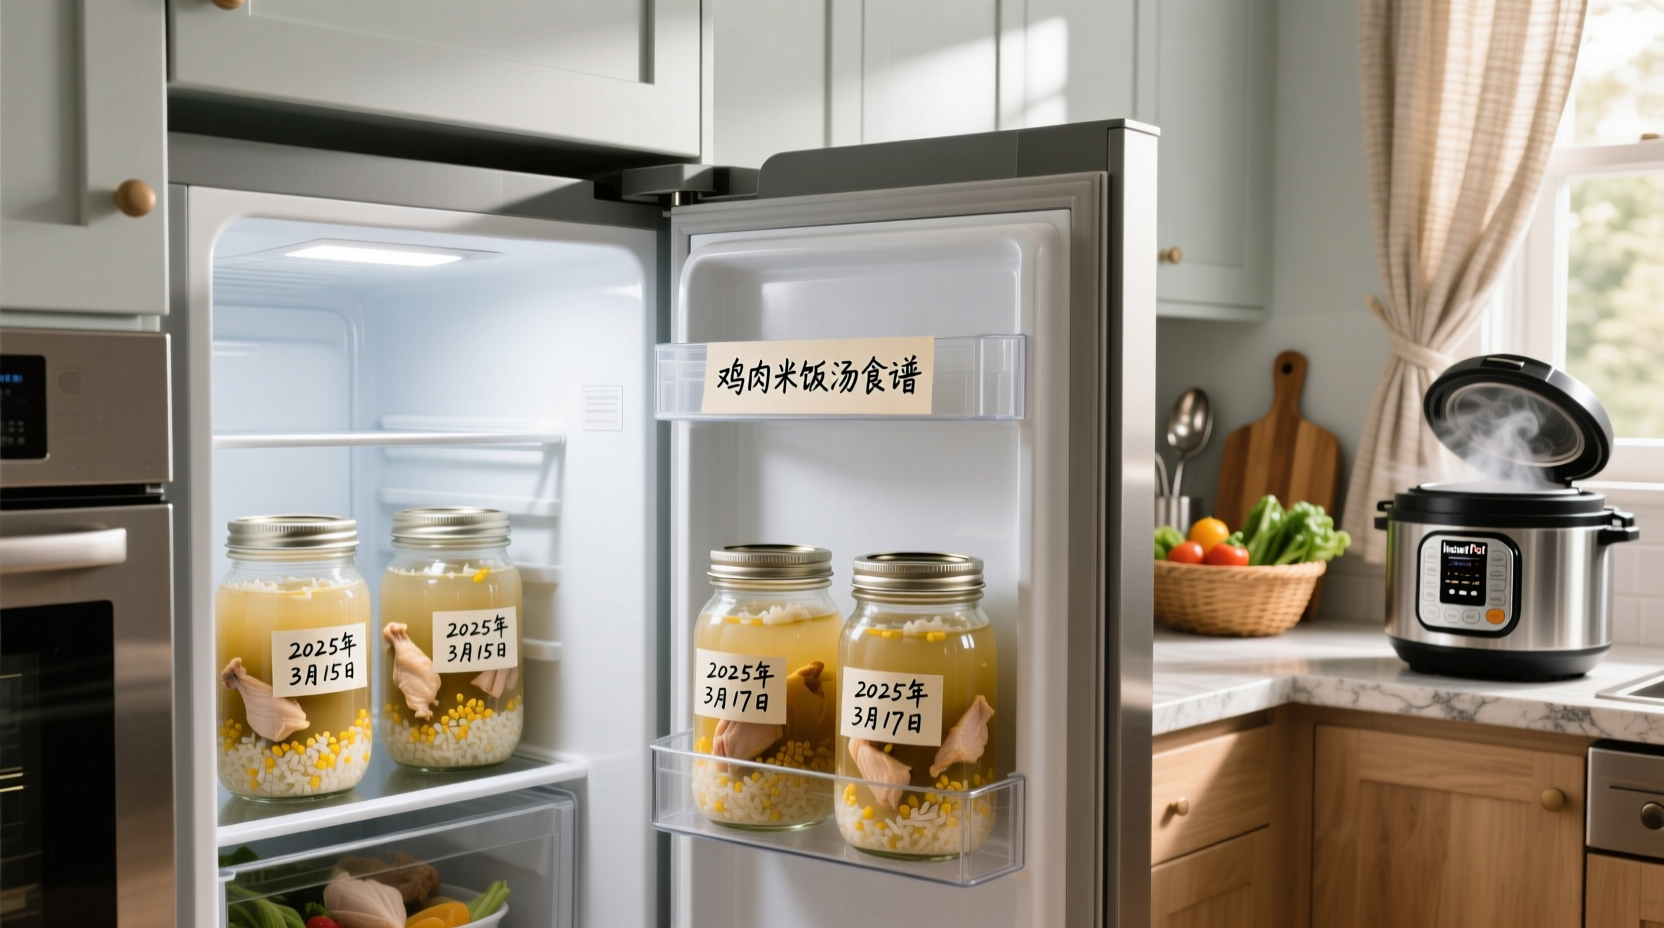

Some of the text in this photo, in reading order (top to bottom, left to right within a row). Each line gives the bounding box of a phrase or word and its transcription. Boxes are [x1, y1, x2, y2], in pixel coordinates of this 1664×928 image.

[717, 354, 922, 396] 鸡肉米饭汤食谱
[446, 614, 508, 639] 2025年
[288, 631, 357, 660] 2025年
[447, 642, 507, 663] 3月15日
[289, 661, 355, 686] 3月15日
[706, 660, 775, 689] 2025年
[703, 686, 769, 713] 3月17日
[854, 678, 929, 709] 2025年
[851, 706, 922, 736] 3月17日
